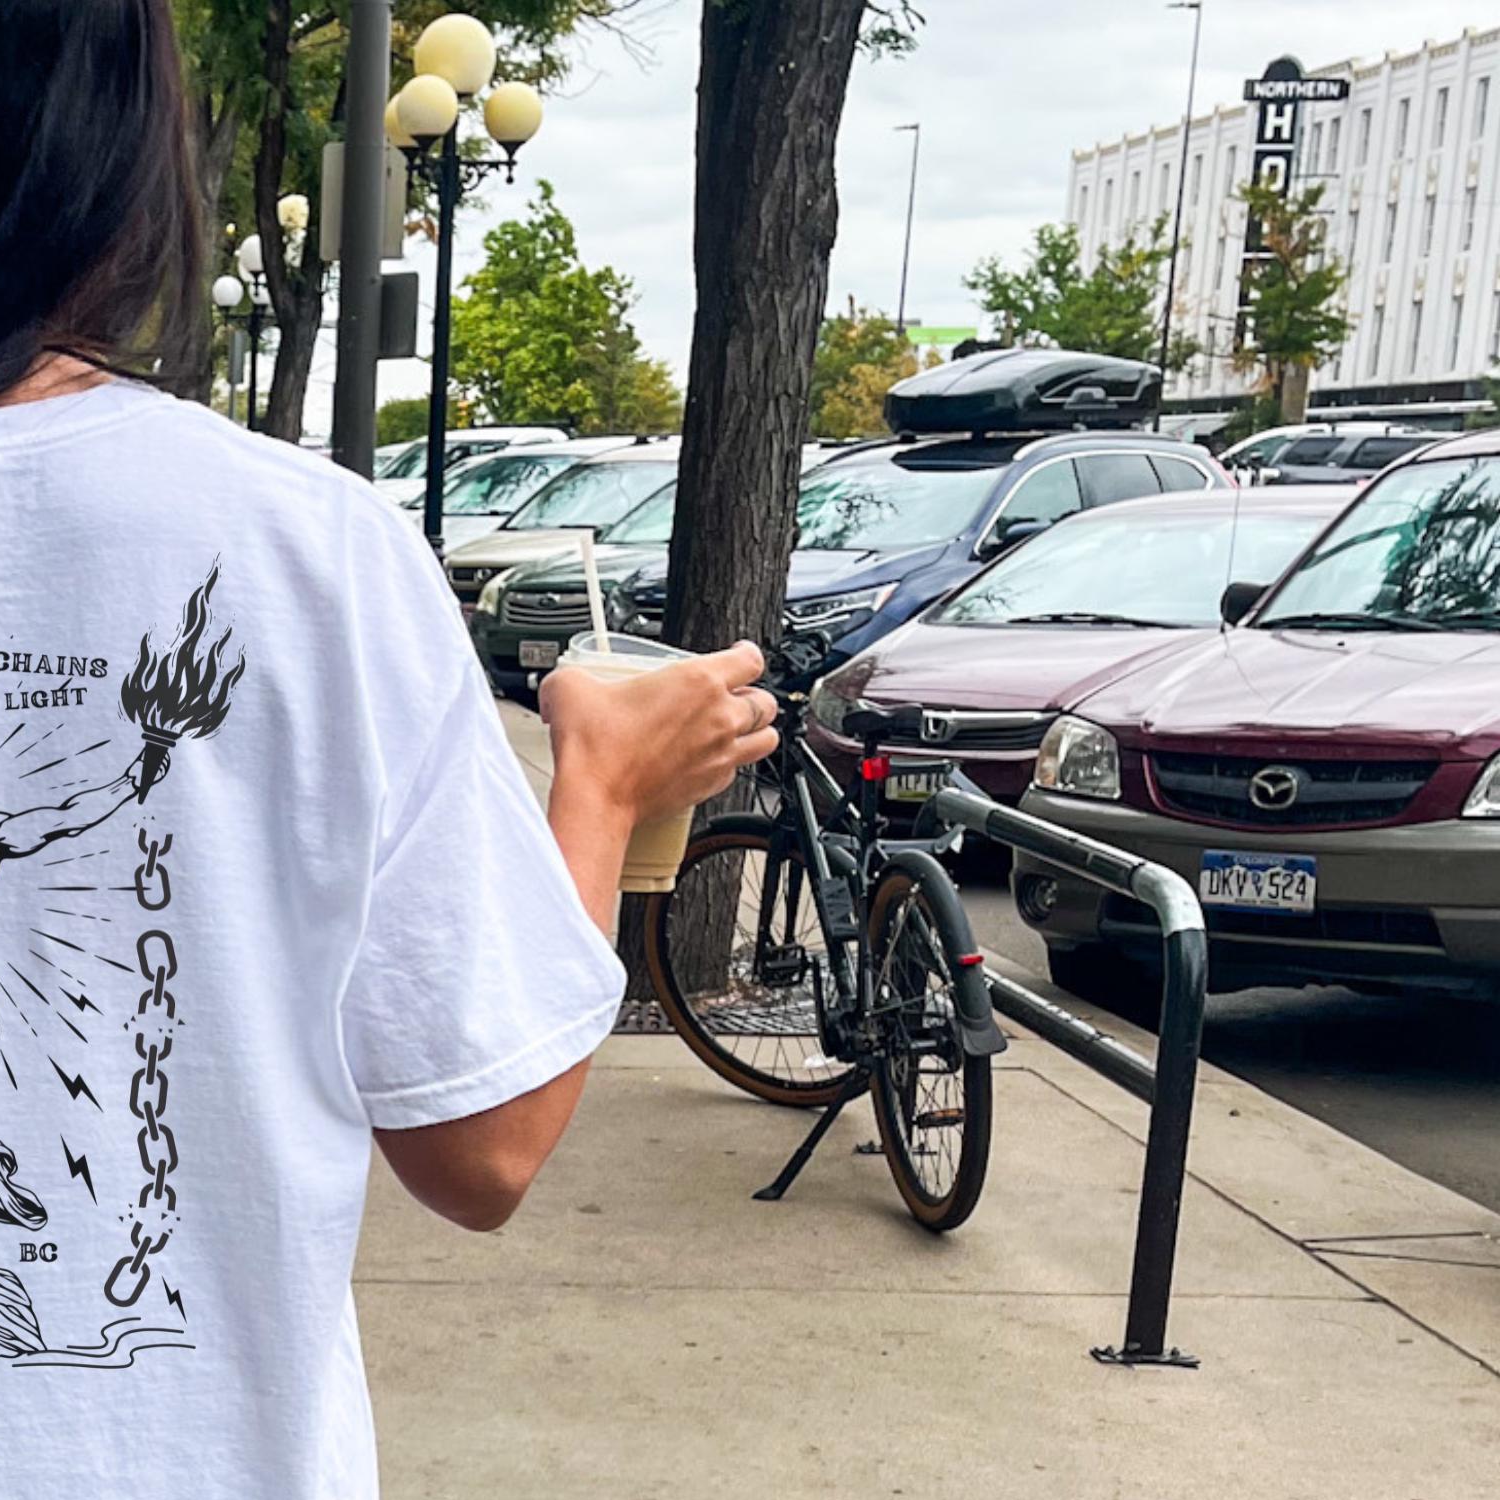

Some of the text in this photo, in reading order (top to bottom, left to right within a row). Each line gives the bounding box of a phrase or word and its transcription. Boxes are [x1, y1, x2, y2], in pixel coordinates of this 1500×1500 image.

[1253, 81, 1340, 98] NORTHERN
[5, 687, 88, 710] LIGHT
[20, 1243, 57, 1262] BC
